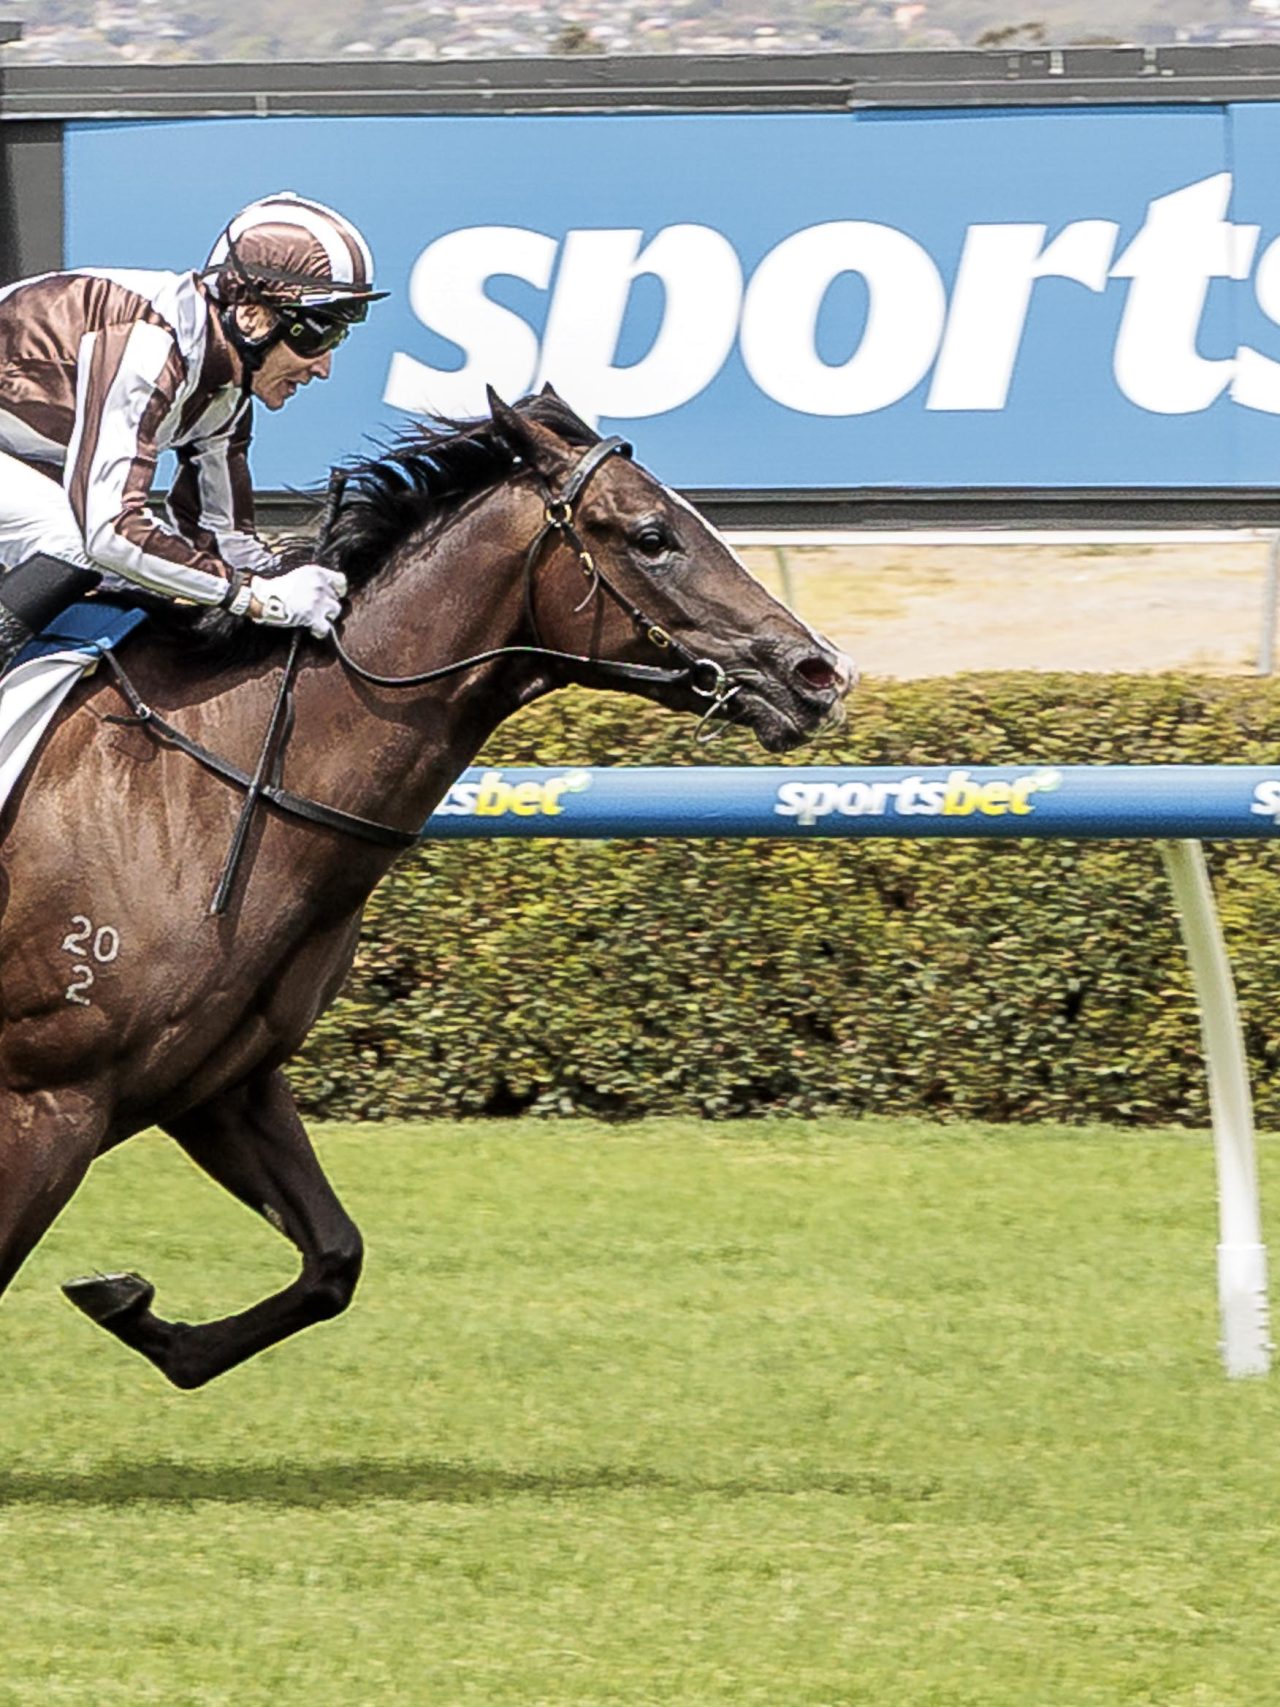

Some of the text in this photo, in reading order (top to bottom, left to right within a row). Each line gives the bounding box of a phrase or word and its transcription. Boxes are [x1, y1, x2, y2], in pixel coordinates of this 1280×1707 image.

[382, 172, 1280, 434] sport
[774, 770, 1038, 826] sportsbet
[61, 914, 120, 963] 20
[65, 964, 94, 1006] 2
